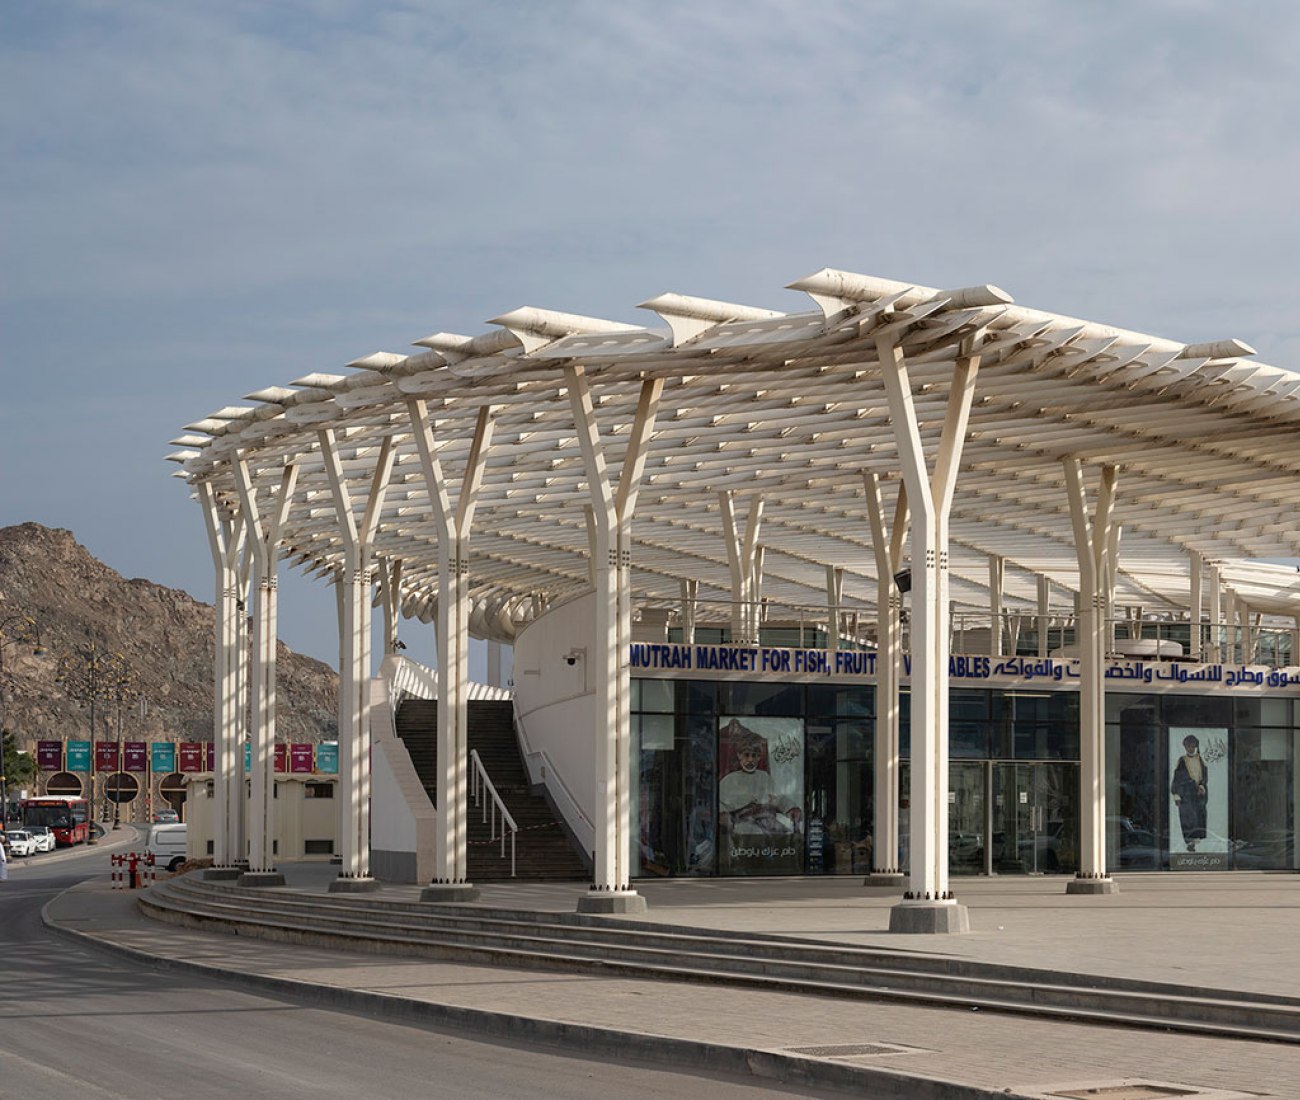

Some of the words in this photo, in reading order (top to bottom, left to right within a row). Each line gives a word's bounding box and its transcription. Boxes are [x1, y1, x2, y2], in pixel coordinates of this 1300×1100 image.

[629, 643, 692, 669] MUTRAH
[697, 646, 758, 671] MARKET
[762, 648, 791, 672] FOR
[795, 650, 831, 676] FISH,
[835, 652, 877, 675] FRUIT
[902, 654, 991, 679] VABLES
[993, 657, 1063, 681] والفواكه
[1225, 666, 1264, 687] مطرح
